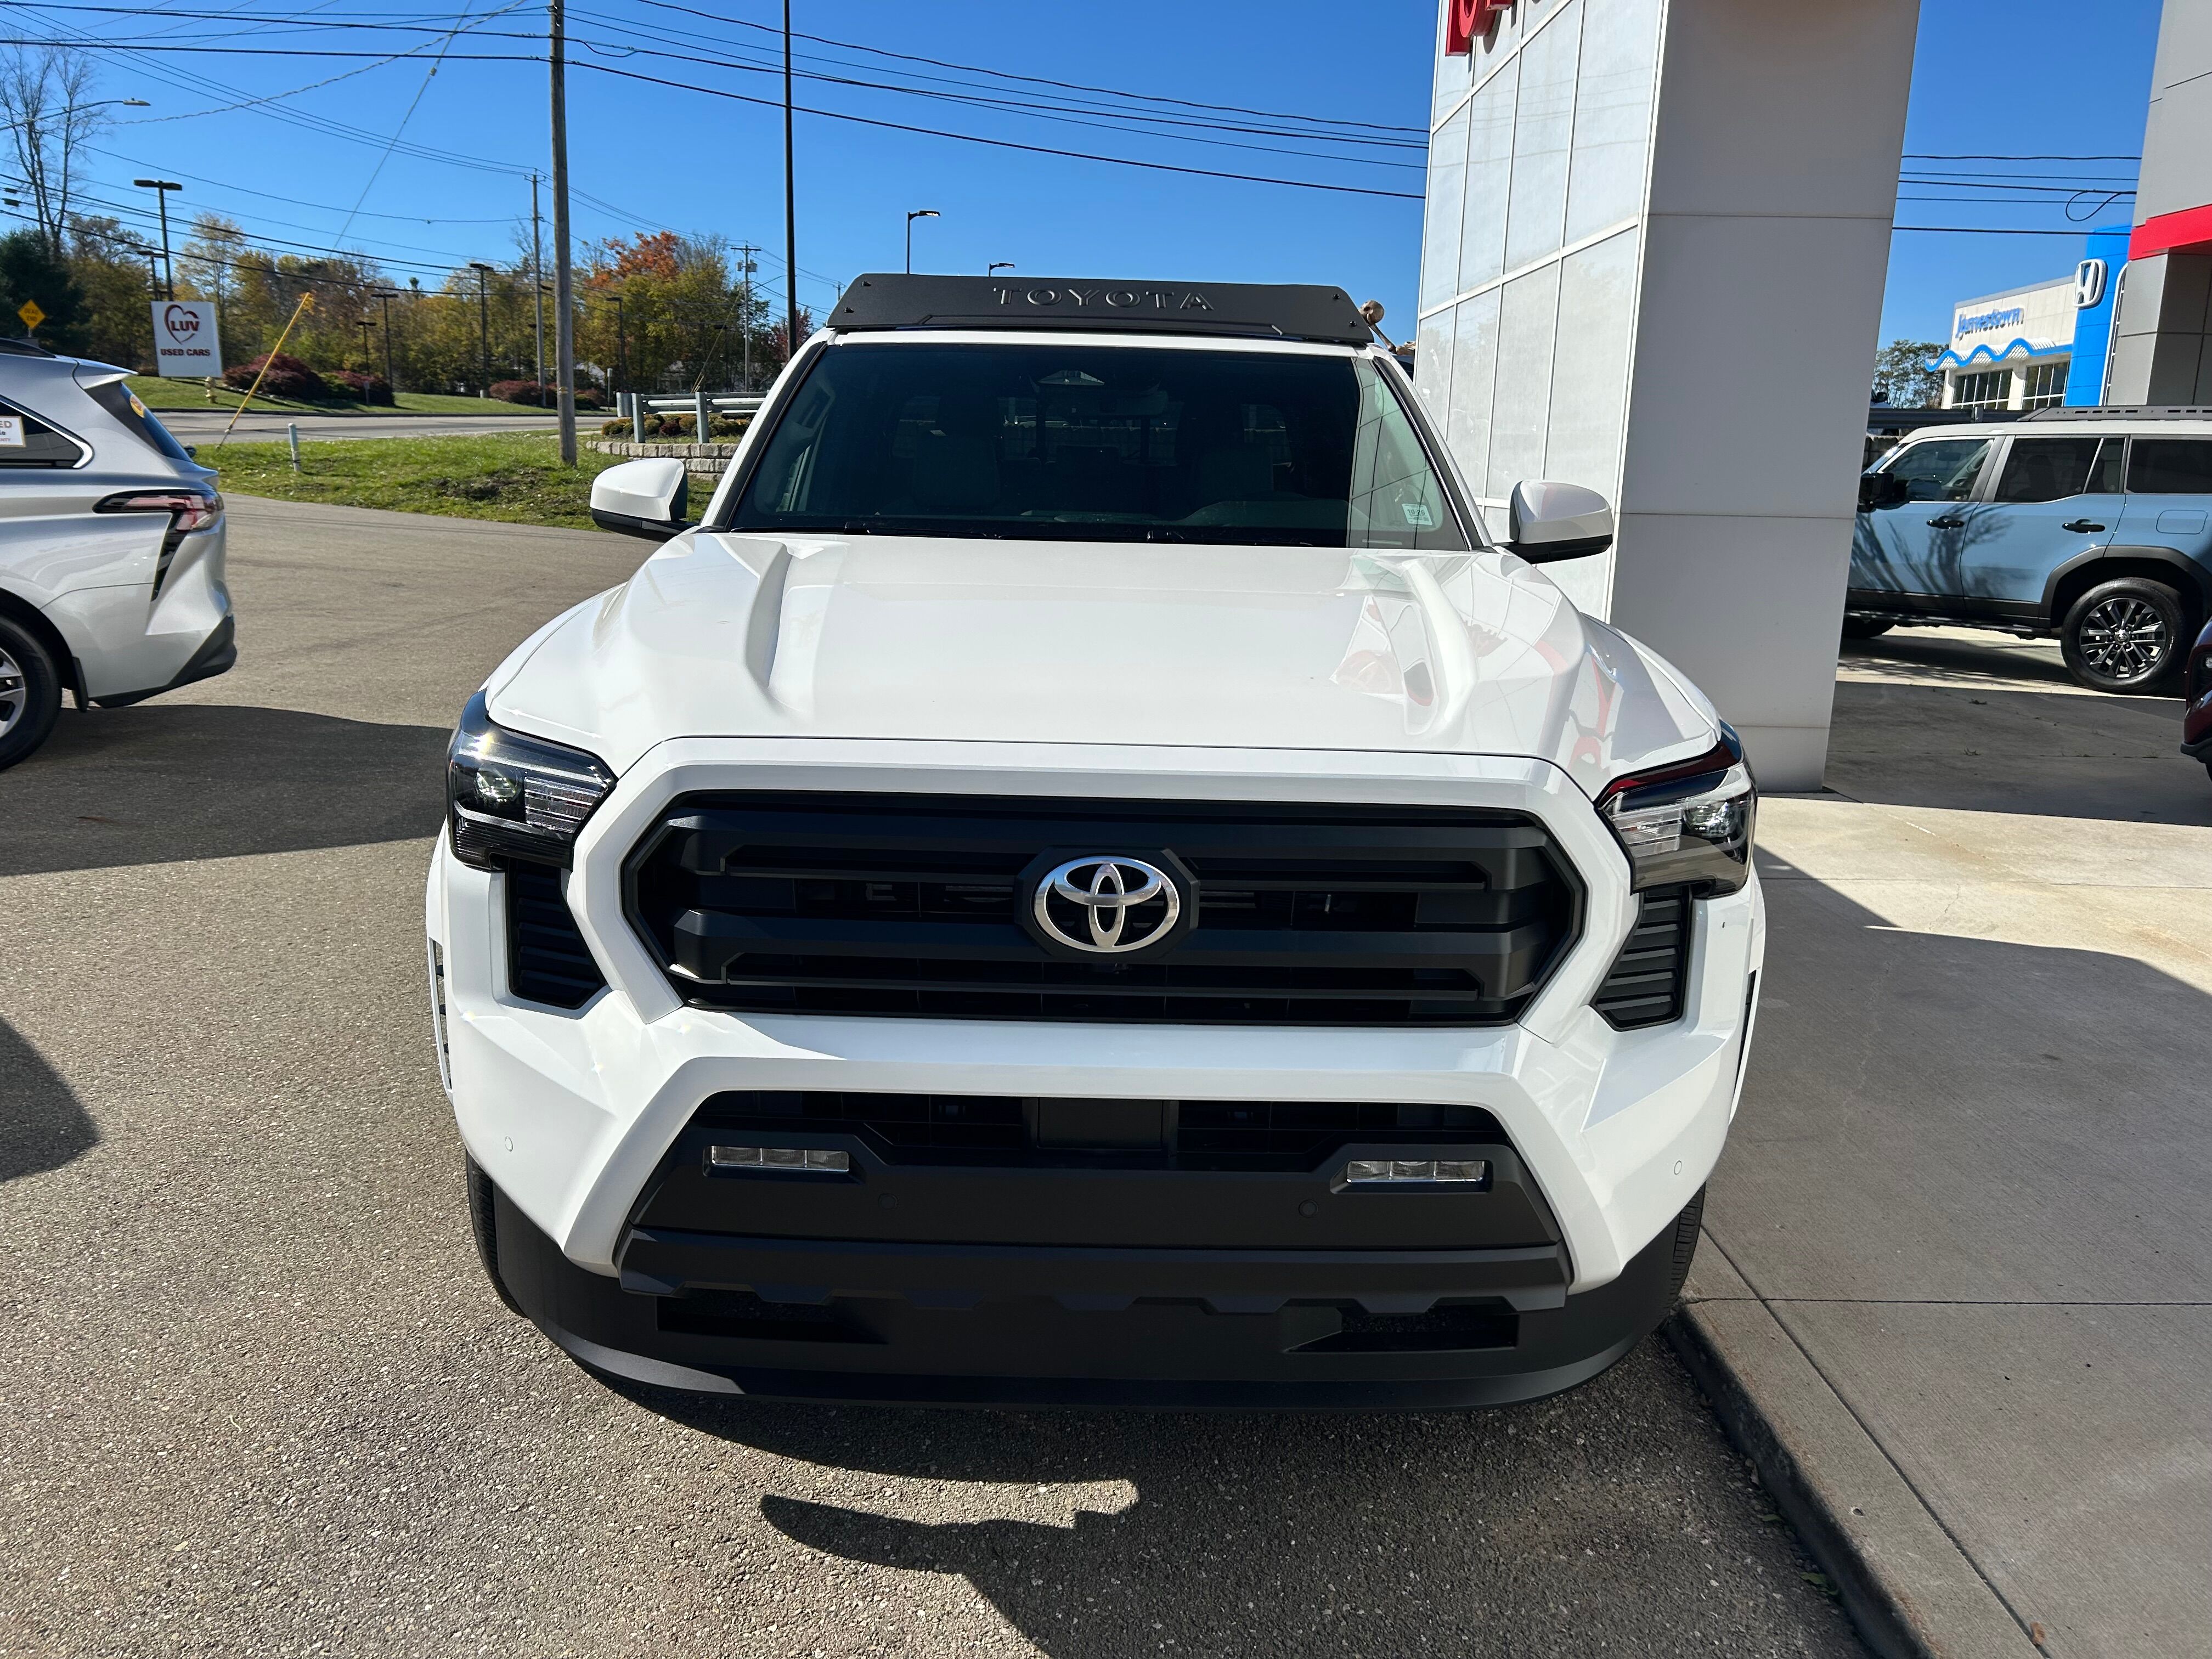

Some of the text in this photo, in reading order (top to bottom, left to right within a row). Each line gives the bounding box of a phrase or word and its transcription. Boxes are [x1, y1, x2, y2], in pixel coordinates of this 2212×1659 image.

[992, 287, 1214, 311] TOYOTA
[171, 320, 199, 331] LUV
[1955, 307, 2023, 339] Jamestown
